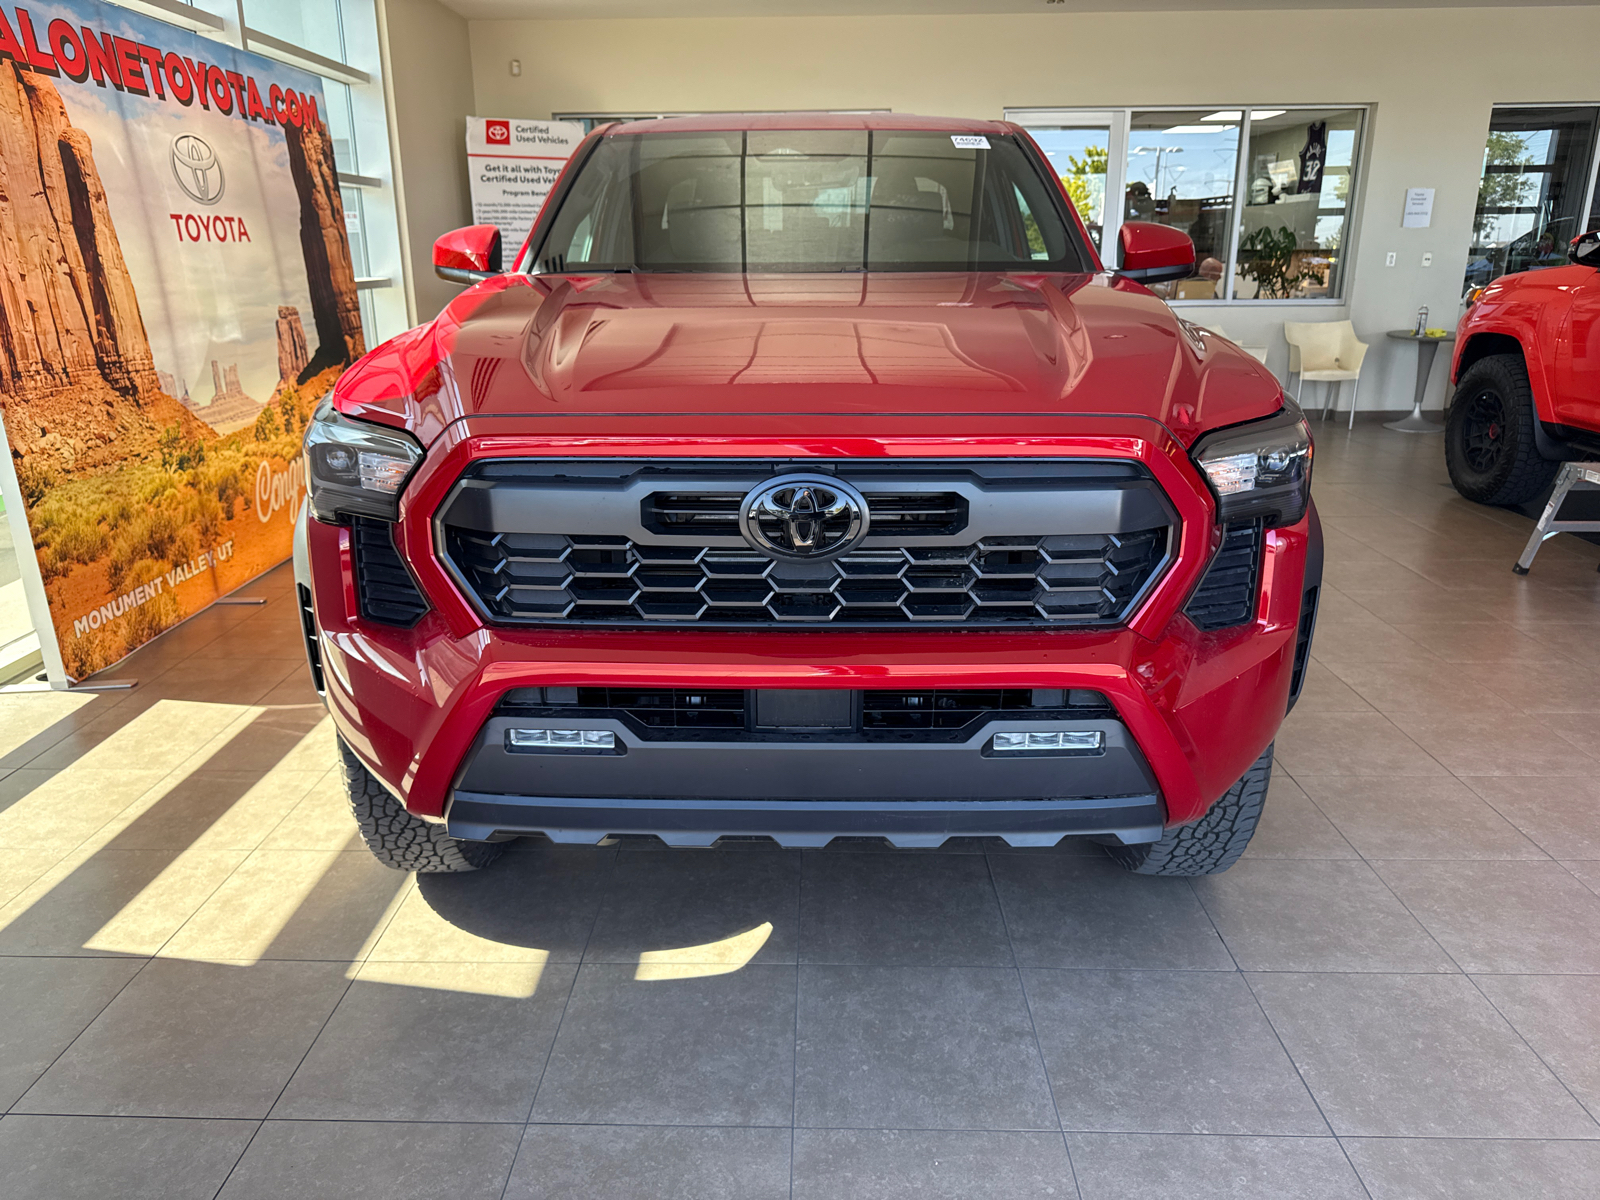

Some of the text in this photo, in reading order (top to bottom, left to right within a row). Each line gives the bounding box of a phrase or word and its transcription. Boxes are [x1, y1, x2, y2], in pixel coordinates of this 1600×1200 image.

[515, 125, 549, 134] Certified
[516, 135, 569, 145] Used Vehicles
[485, 164, 501, 172] Get
[511, 165, 521, 173] all
[523, 166, 542, 174] with
[1303, 160, 1321, 181] 32
[480, 174, 518, 183] Certified
[519, 176, 541, 184] Used
[502, 189, 530, 197] Program
[169, 213, 252, 243] TOYOTA
[73, 540, 234, 639] MONUMENT VALLEY, UT
